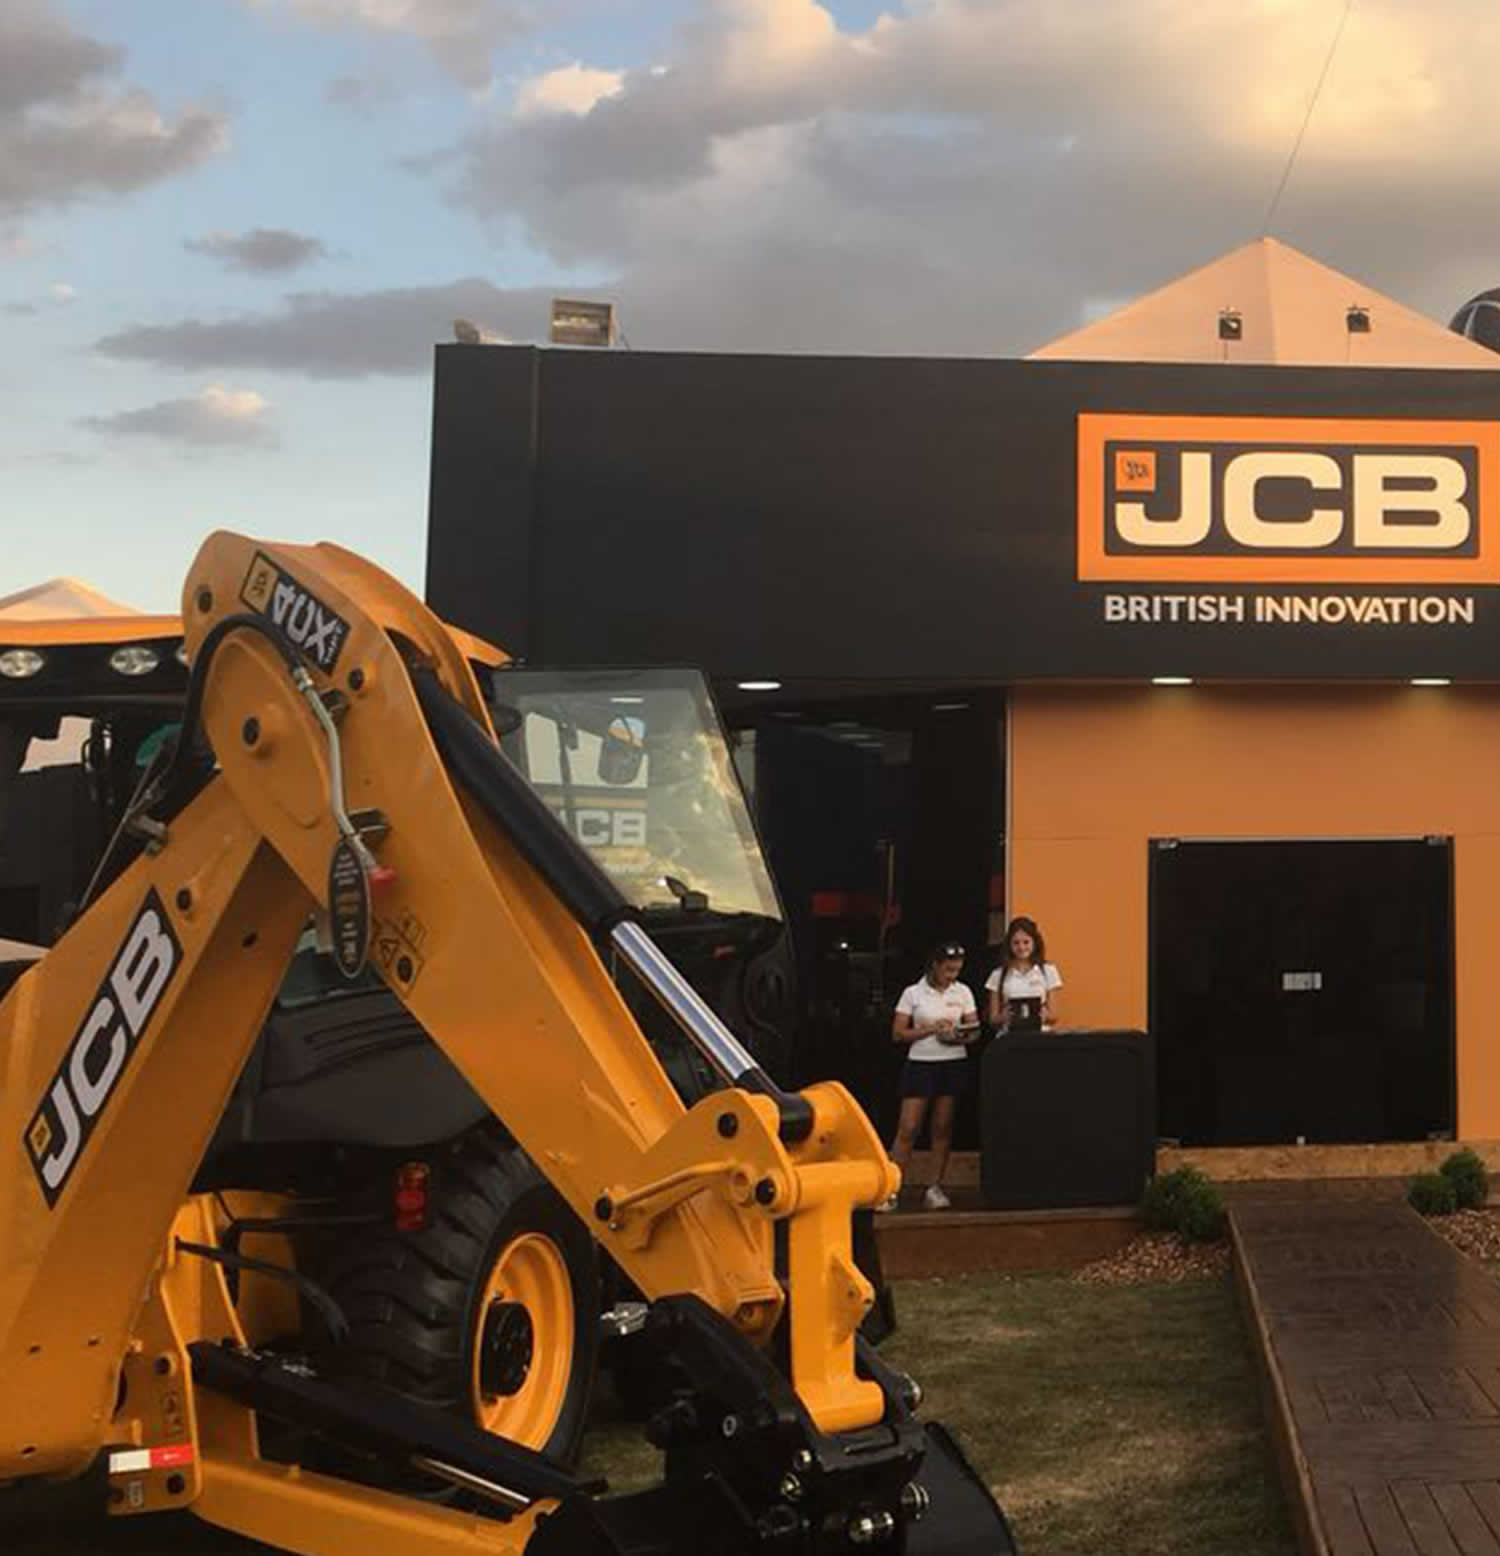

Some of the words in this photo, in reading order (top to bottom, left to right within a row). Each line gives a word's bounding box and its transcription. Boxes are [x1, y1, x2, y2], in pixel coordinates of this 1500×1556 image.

[1114, 450, 1471, 549] JCB
[1104, 595, 1245, 623] BRITISH
[1255, 597, 1475, 625] INNOVATION
[41, 908, 175, 1190] JCB
